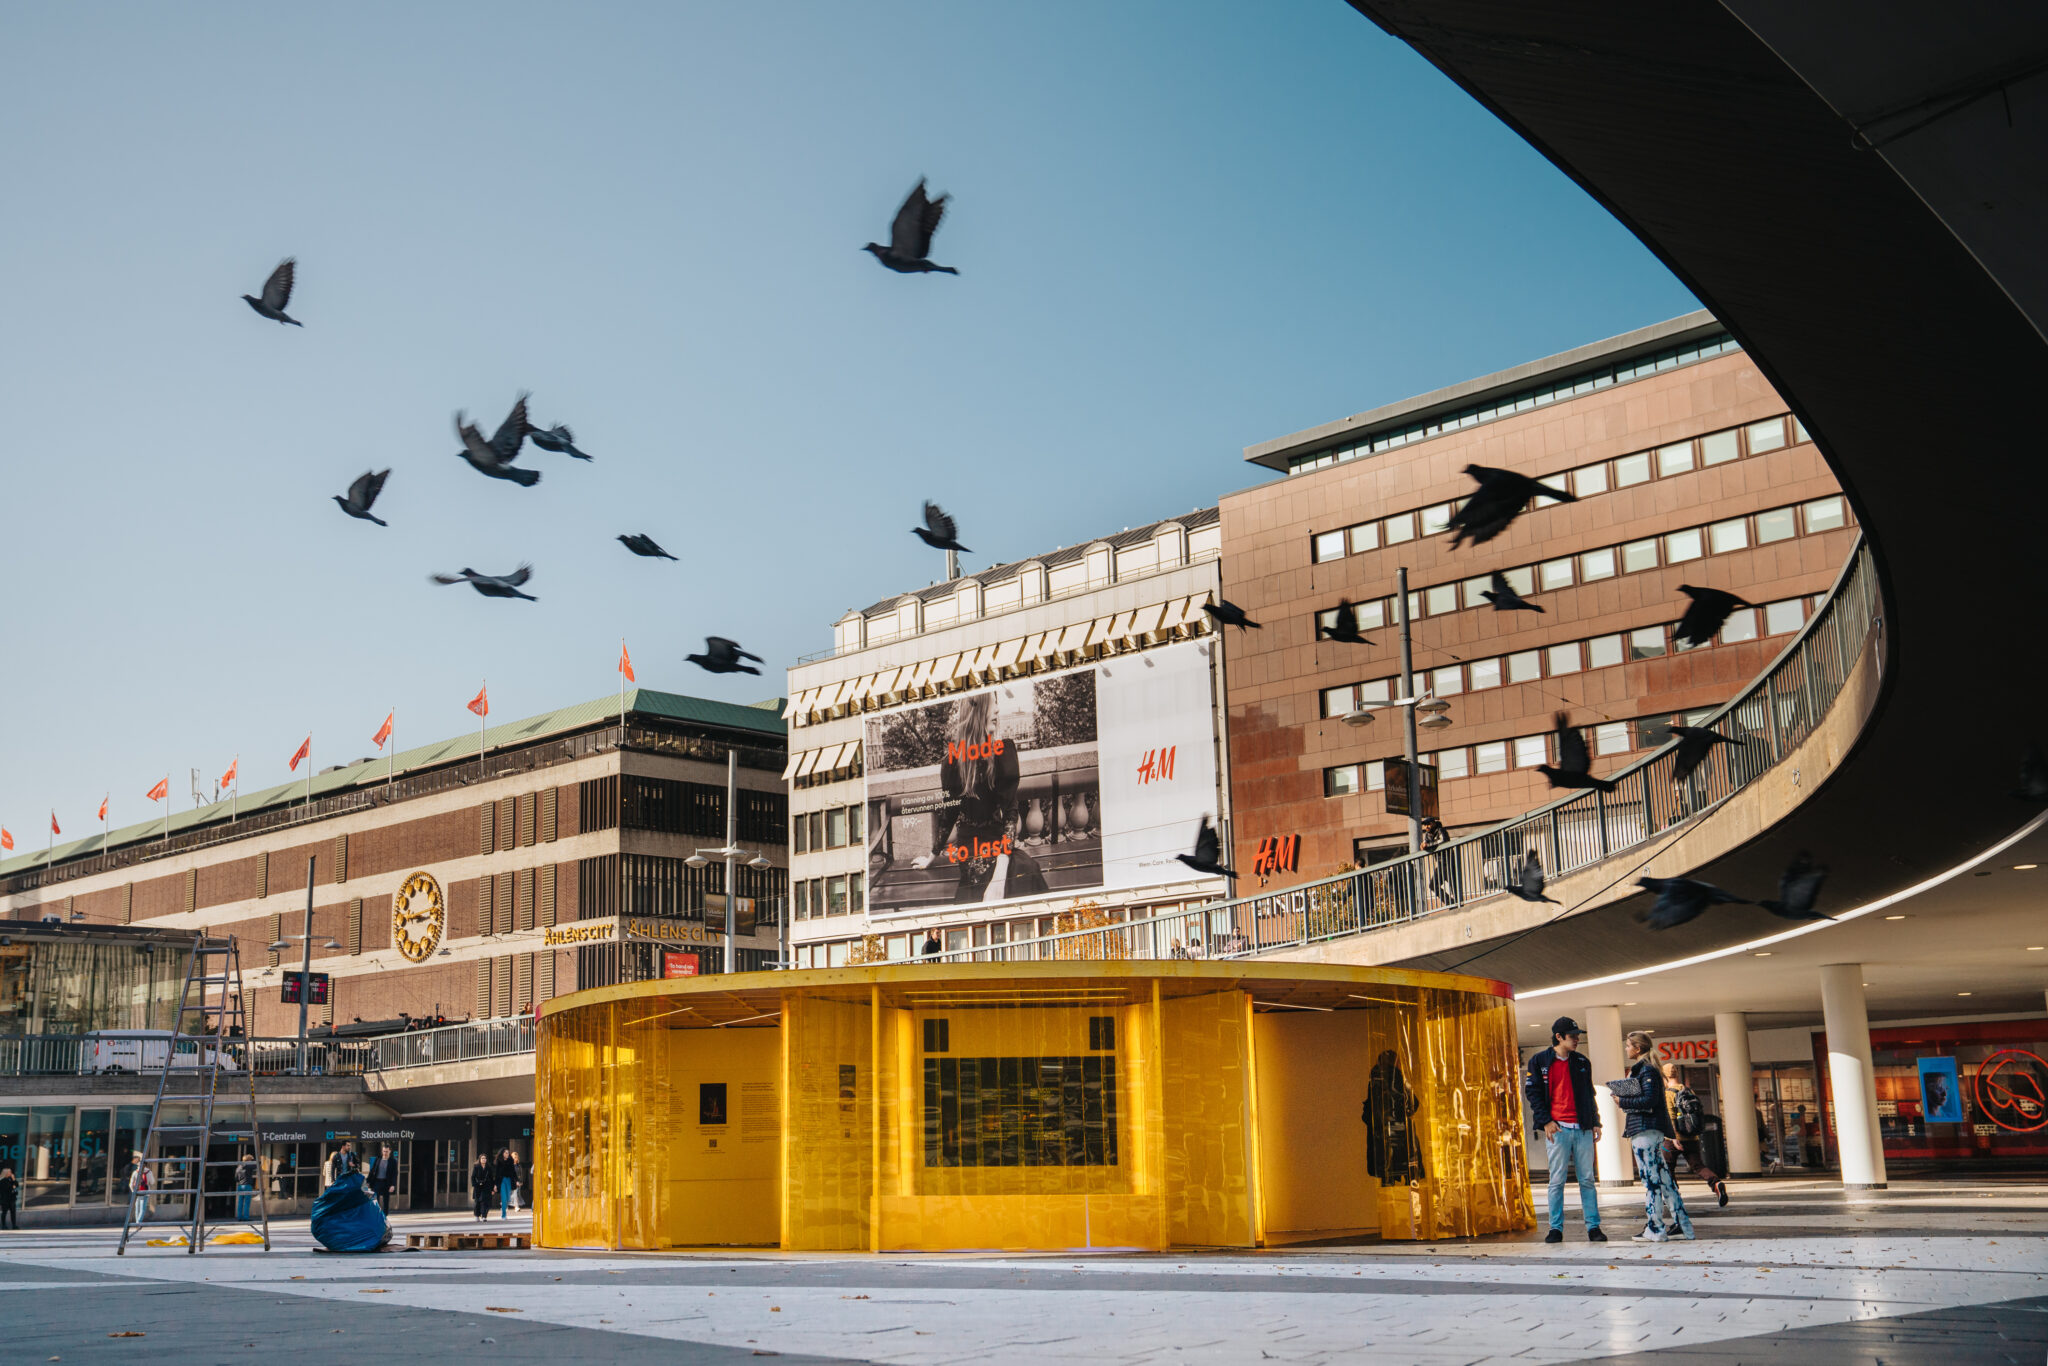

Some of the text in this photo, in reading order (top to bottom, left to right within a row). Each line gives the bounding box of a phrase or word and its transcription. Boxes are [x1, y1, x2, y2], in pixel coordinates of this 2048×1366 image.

[948, 734, 1004, 765] Made
[1136, 744, 1177, 785] H&M
[901, 796, 926, 805] Klänning
[934, 790, 951, 800] 100%
[901, 799, 962, 815] återvunnen polyester
[946, 834, 1012, 864] to last
[1252, 833, 1298, 876] H&M
[544, 923, 613, 945] ÅHLÉNS CITY
[629, 918, 689, 940] ÅHLÉNS
[1658, 1040, 1719, 1060] SYNSA
[262, 1132, 307, 1141] T-Centralen
[361, 1130, 399, 1139] Stockholm
[400, 1129, 415, 1140] City
